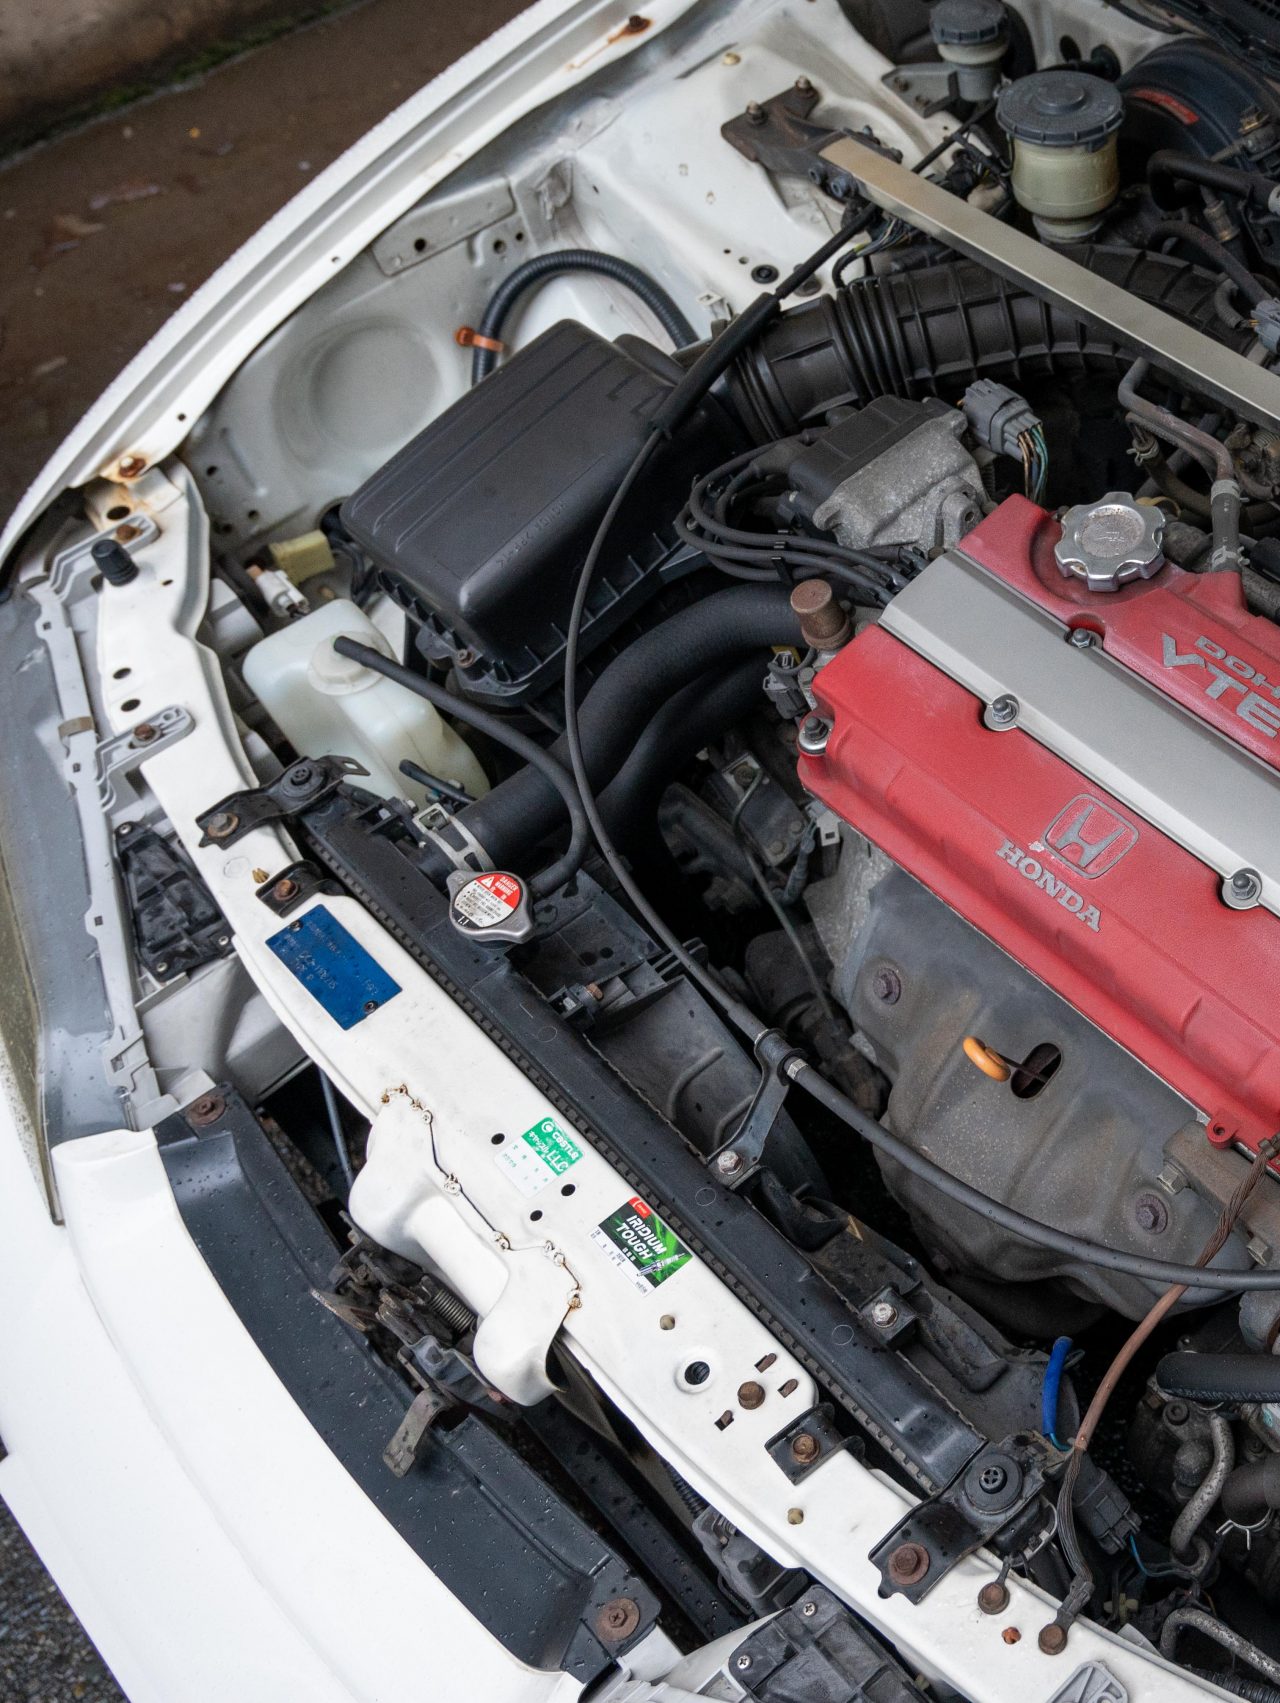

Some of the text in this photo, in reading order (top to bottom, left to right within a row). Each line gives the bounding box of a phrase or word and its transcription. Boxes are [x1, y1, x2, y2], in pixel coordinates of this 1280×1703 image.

[499, 875, 518, 892] DANGER
[995, 838, 1102, 932] HONDA
[546, 1149, 569, 1172] LLC
[615, 1222, 653, 1260] TOUGH
[626, 1212, 667, 1254] IRIDIUM
